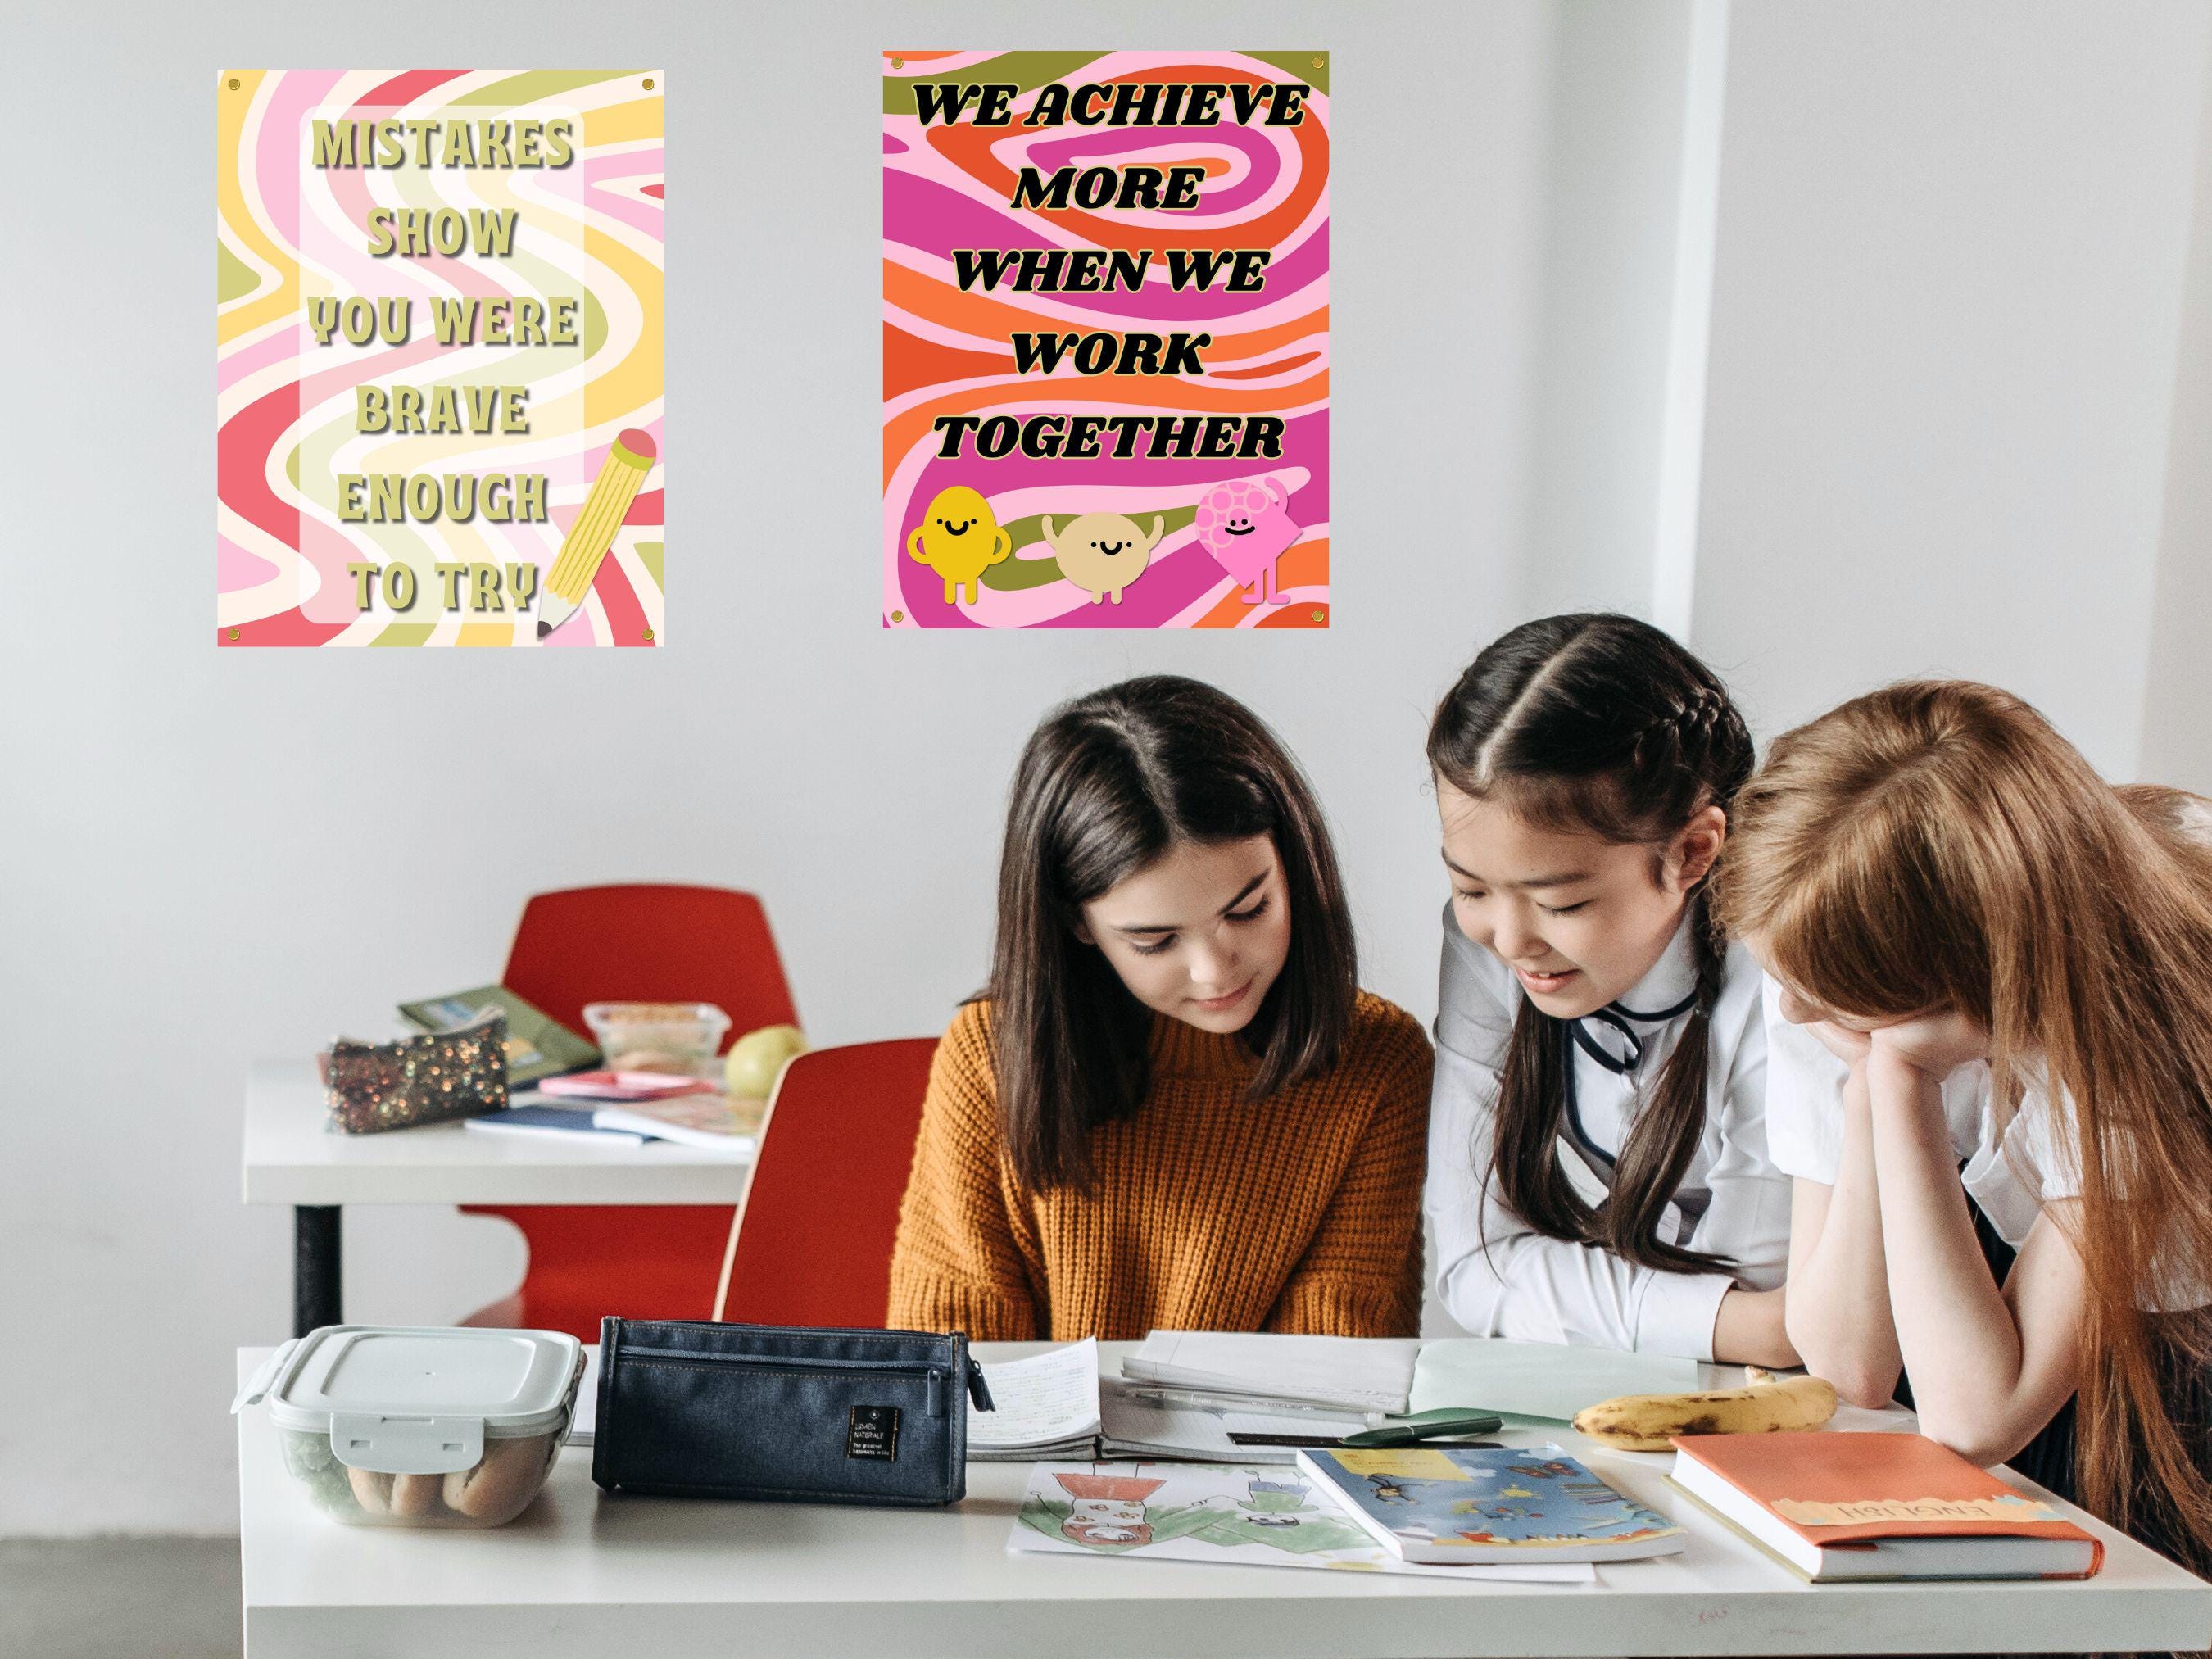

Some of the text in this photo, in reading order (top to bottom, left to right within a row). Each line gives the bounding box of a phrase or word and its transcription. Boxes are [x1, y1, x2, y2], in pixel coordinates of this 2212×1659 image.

[913, 84, 1310, 125] WE ACHIEVE
[311, 119, 573, 168] MISTAKES
[1010, 167, 1205, 209] MORE
[367, 207, 518, 256] SHOW
[953, 251, 1271, 292] WHEN WE
[307, 296, 579, 345] YOU WERE
[1012, 333, 1211, 375] WORK
[356, 384, 531, 433] BRAVE
[934, 415, 1285, 458] TOGETHER
[336, 473, 548, 523] ENOUGH
[347, 561, 537, 610] TO TRY
[1838, 1506, 1991, 1518] ENGLISH
